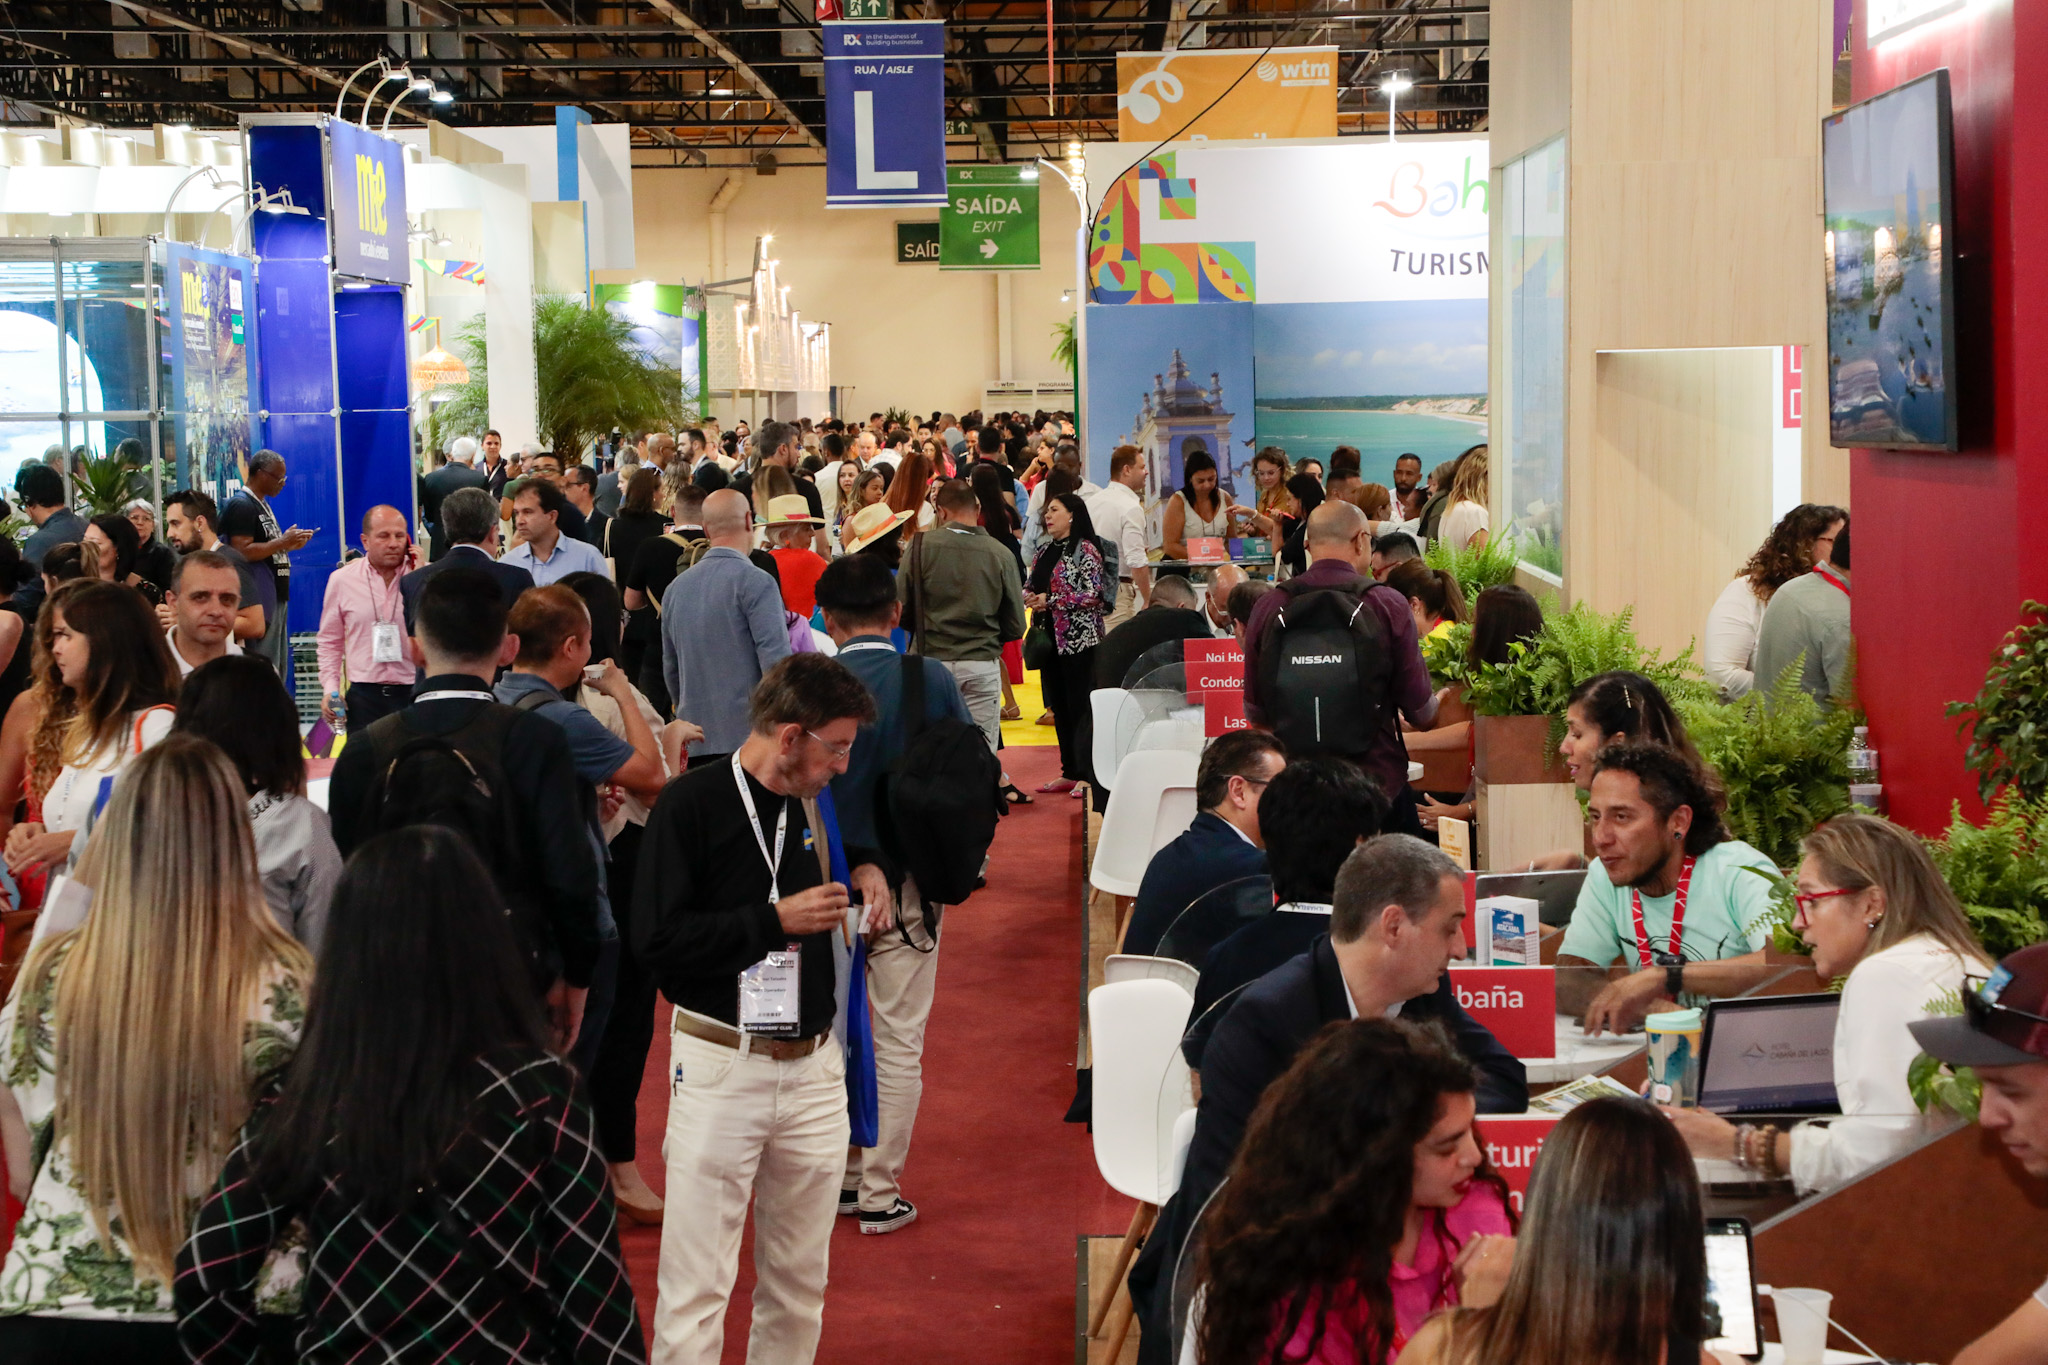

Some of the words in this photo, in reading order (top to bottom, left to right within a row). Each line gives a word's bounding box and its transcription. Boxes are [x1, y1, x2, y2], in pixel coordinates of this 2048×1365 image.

[843, 34, 862, 46] RX
[854, 65, 877, 74] RUA
[879, 64, 885, 75] /
[886, 65, 914, 74] AISLE
[1281, 60, 1330, 78] wtm
[854, 90, 918, 189] L
[956, 194, 1022, 214] SAÍDA
[972, 221, 1005, 233] EXIT
[904, 240, 940, 258] SAÍD
[1206, 652, 1225, 662] Noi
[1291, 655, 1342, 665] NISSAN
[1224, 716, 1247, 728] Las
